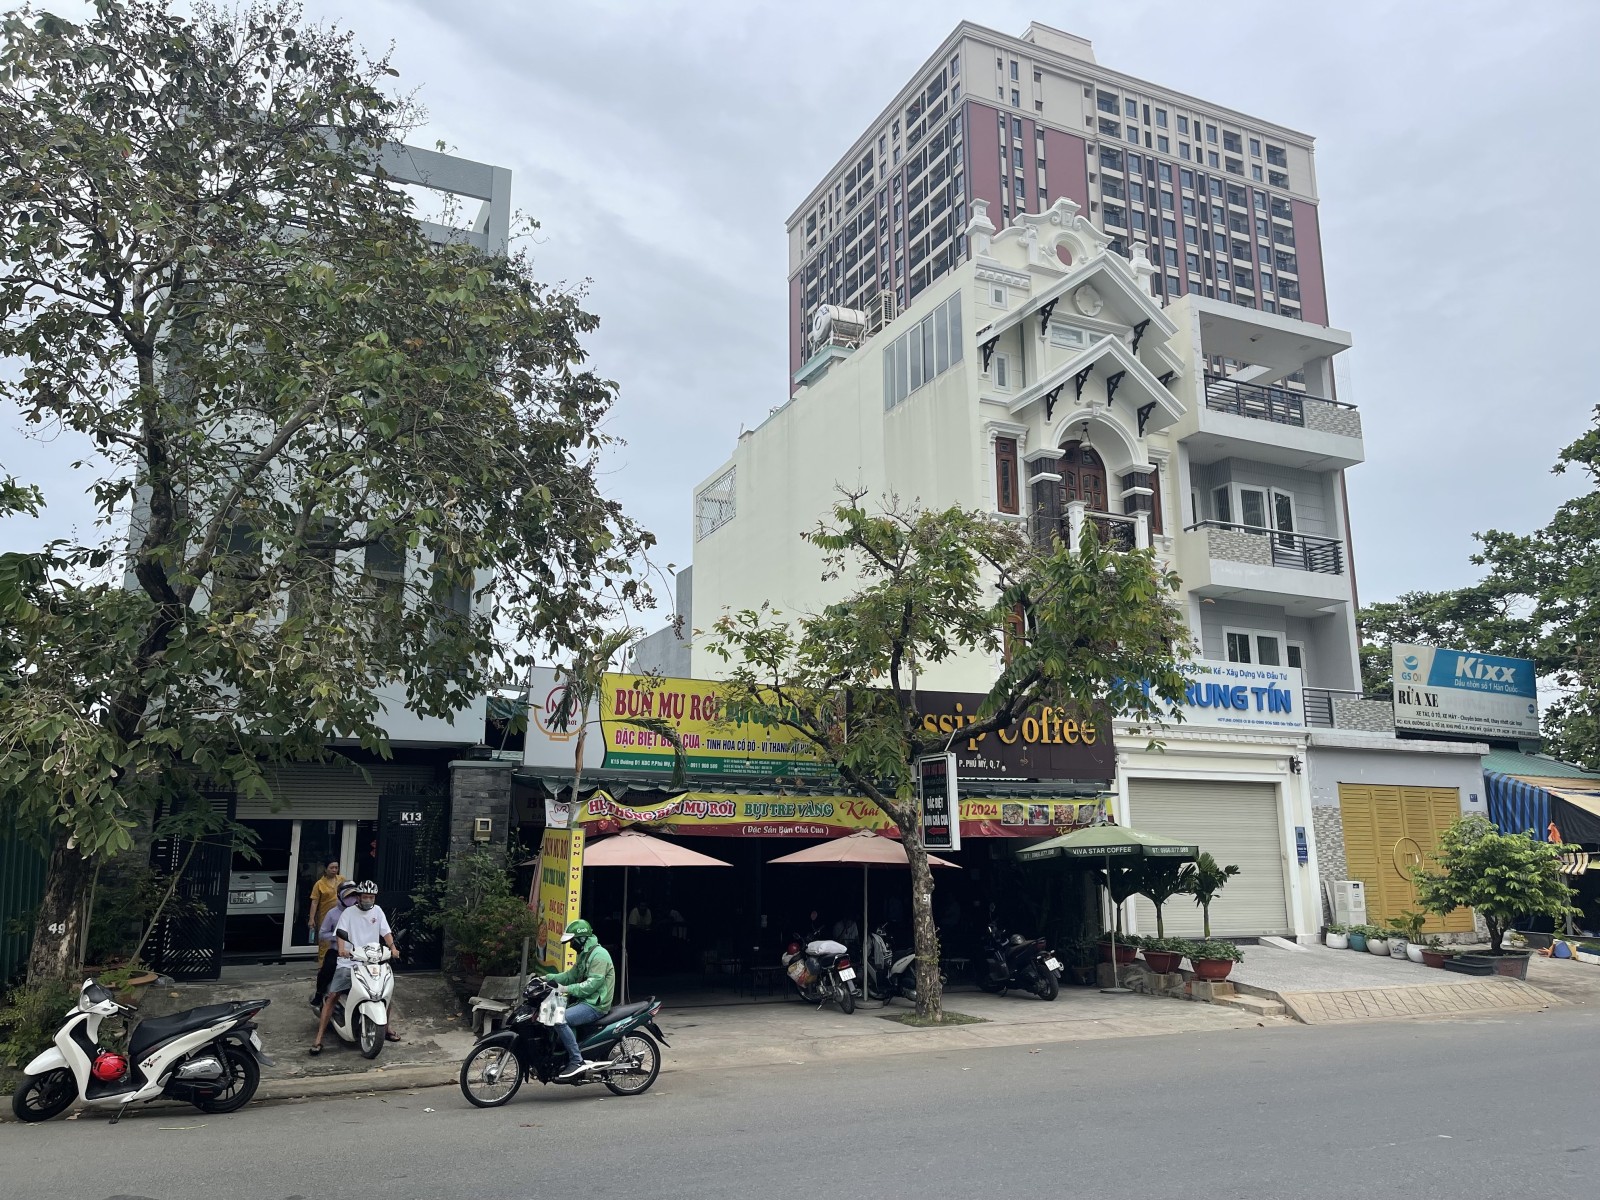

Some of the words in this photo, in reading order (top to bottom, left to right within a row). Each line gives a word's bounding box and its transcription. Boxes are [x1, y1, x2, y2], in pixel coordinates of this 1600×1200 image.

[1226, 669, 1239, 679] Xây
[1239, 669, 1256, 680] Dựng
[1257, 669, 1265, 678] Và
[1279, 673, 1288, 681] Tư
[1401, 671, 1411, 680] GS
[1455, 656, 1516, 683] Kixx
[1454, 678, 1466, 688] Dầu
[1481, 681, 1488, 690] số
[1493, 681, 1504, 691] Hàn
[1505, 683, 1518, 693] Quốc
[1166, 682, 1249, 711] RUNG
[1251, 681, 1292, 713] TÍN
[1398, 686, 1422, 706] RỬA
[1424, 692, 1439, 708] XE
[658, 691, 685, 726] MỤ
[919, 702, 987, 751] ssip
[615, 727, 635, 748] ĐẶC
[638, 730, 658, 750] BIỆT
[683, 733, 700, 749] CUA
[706, 738, 720, 750] TINH
[722, 740, 735, 751] HOA
[737, 736, 746, 751] CỐ
[747, 739, 756, 752] ĐÔ
[761, 741, 768, 754] VỊ
[978, 758, 988, 769] MỸ,
[402, 812, 422, 821] K13
[605, 801, 654, 822] THỐNG
[683, 801, 708, 818] MỤ
[708, 800, 736, 817] RƠI
[744, 802, 768, 820] BỤI
[769, 802, 796, 817] TRE
[798, 800, 834, 818] VÀNG
[839, 800, 880, 820] Khai
[795, 824, 809, 834] Chả
[810, 825, 825, 834] Cua
[1106, 846, 1132, 854] COFFEE
[923, 893, 931, 902] 51
[48, 922, 66, 935] 49
